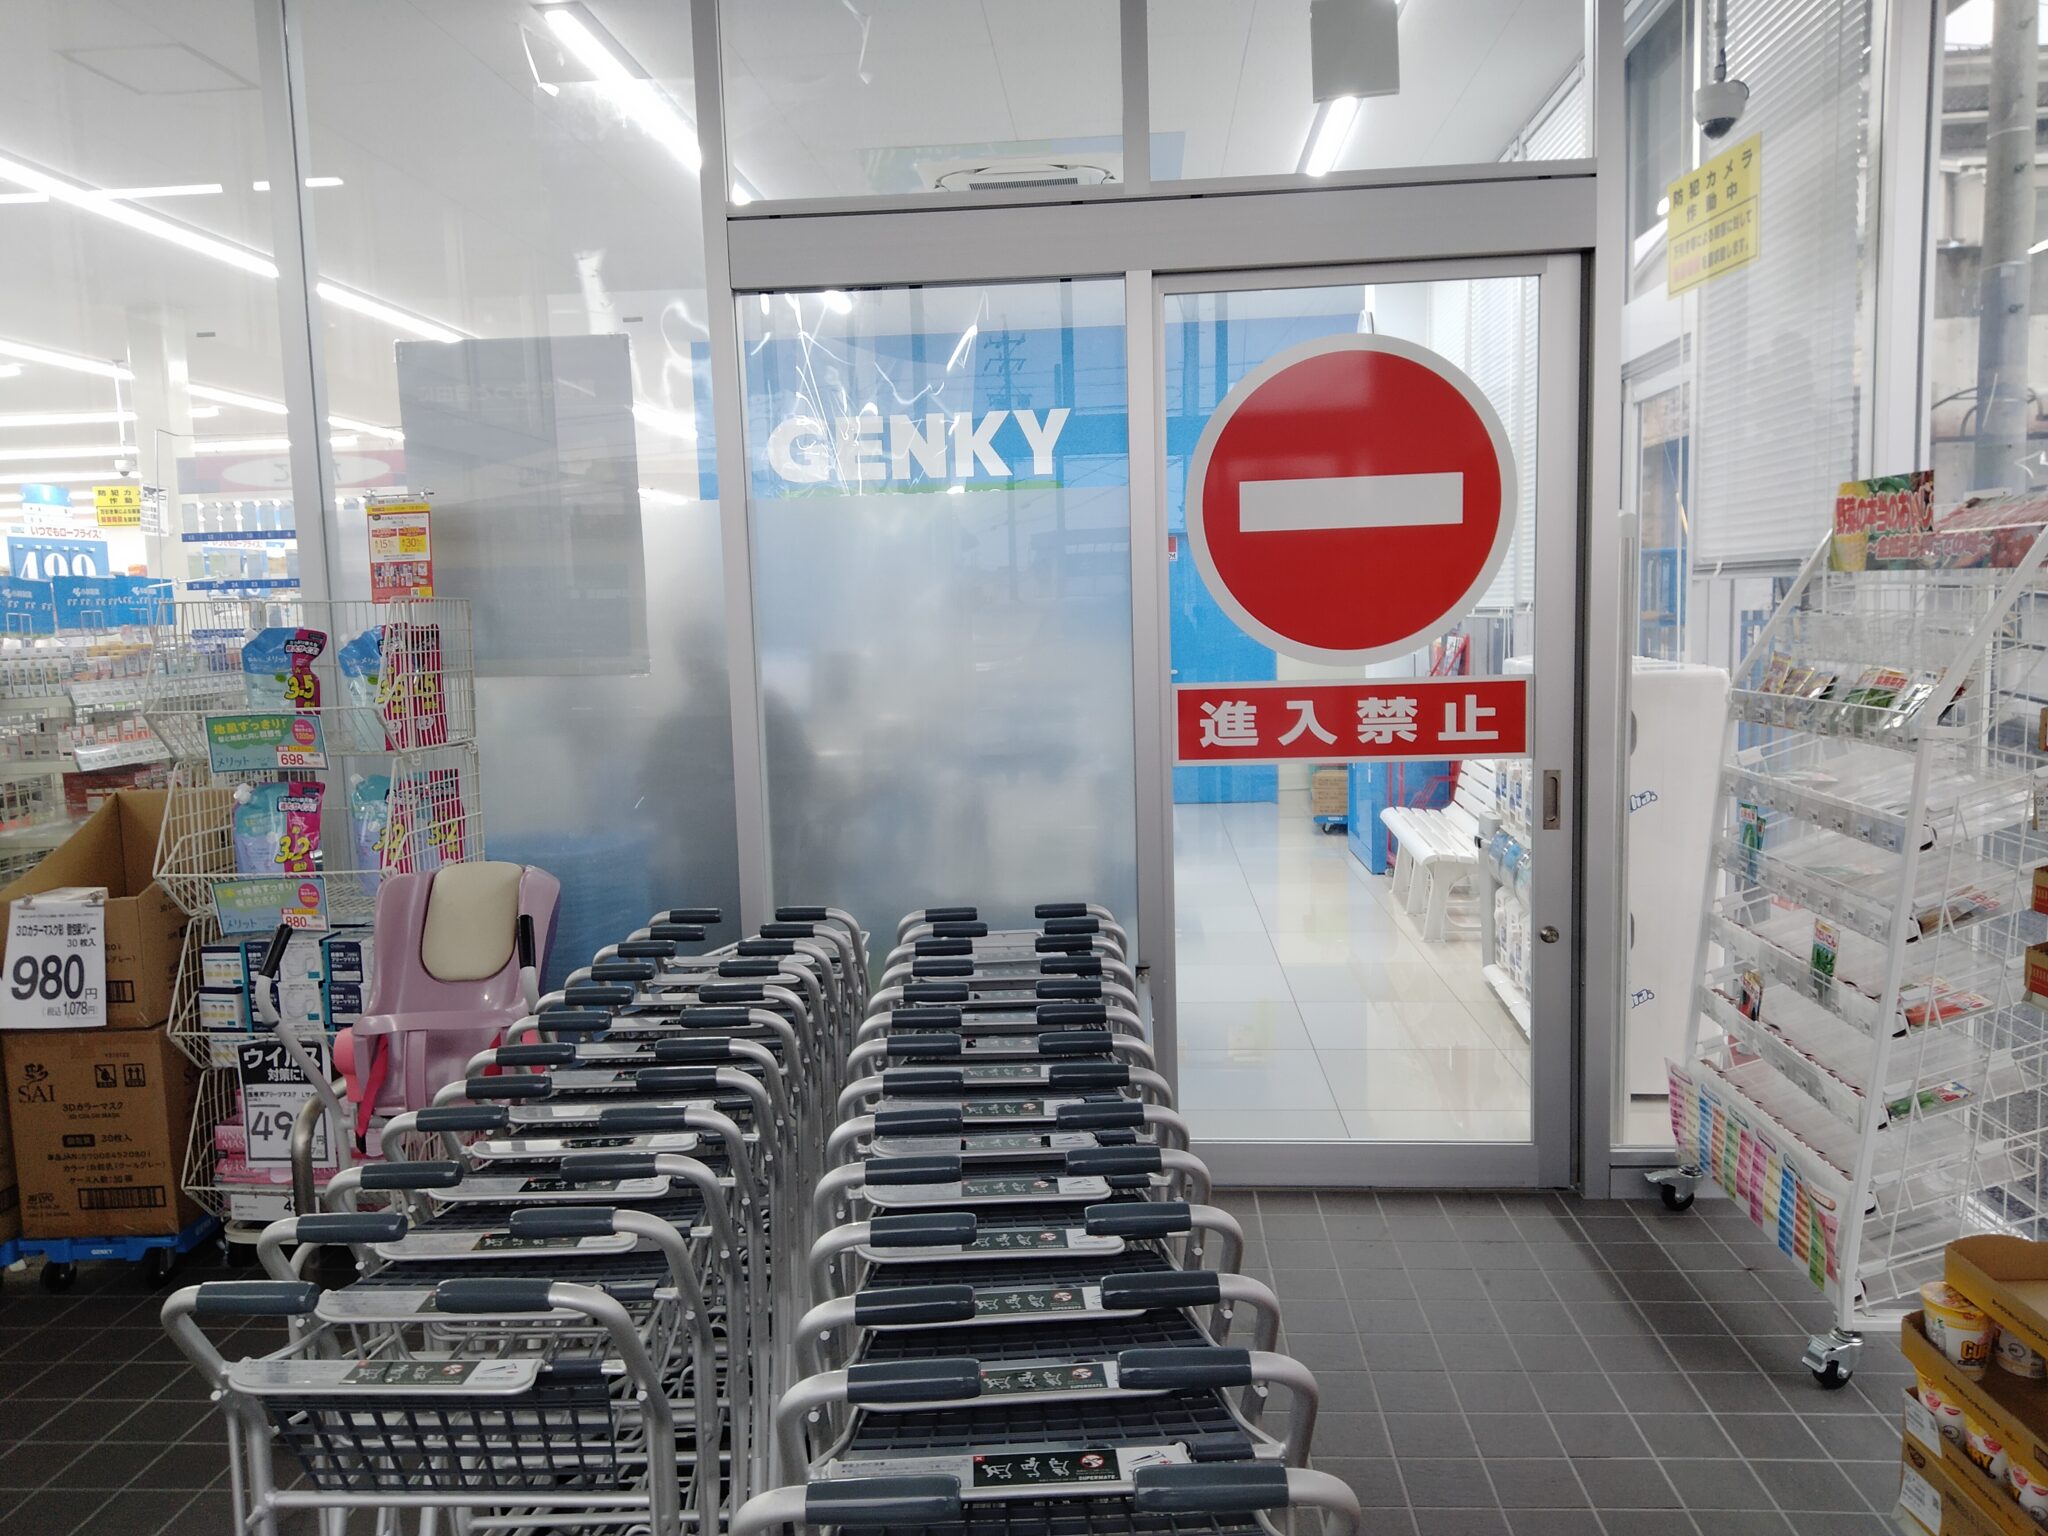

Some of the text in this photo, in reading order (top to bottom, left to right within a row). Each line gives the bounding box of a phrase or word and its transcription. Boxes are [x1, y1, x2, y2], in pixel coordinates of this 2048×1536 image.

[1673, 148, 1754, 208] 防犯カメラ
[1686, 181, 1739, 223] 作動中
[767, 408, 1071, 483] GENKY
[284, 674, 314, 699] 3.5
[1200, 694, 1499, 748] 進入禁止
[281, 753, 304, 765] 698
[274, 835, 311, 863] 3.2
[267, 1068, 305, 1082] 対策に!
[18, 1085, 55, 1103] SAI
[251, 1111, 300, 1141] 49
[222, 1140, 245, 1148] MAS
